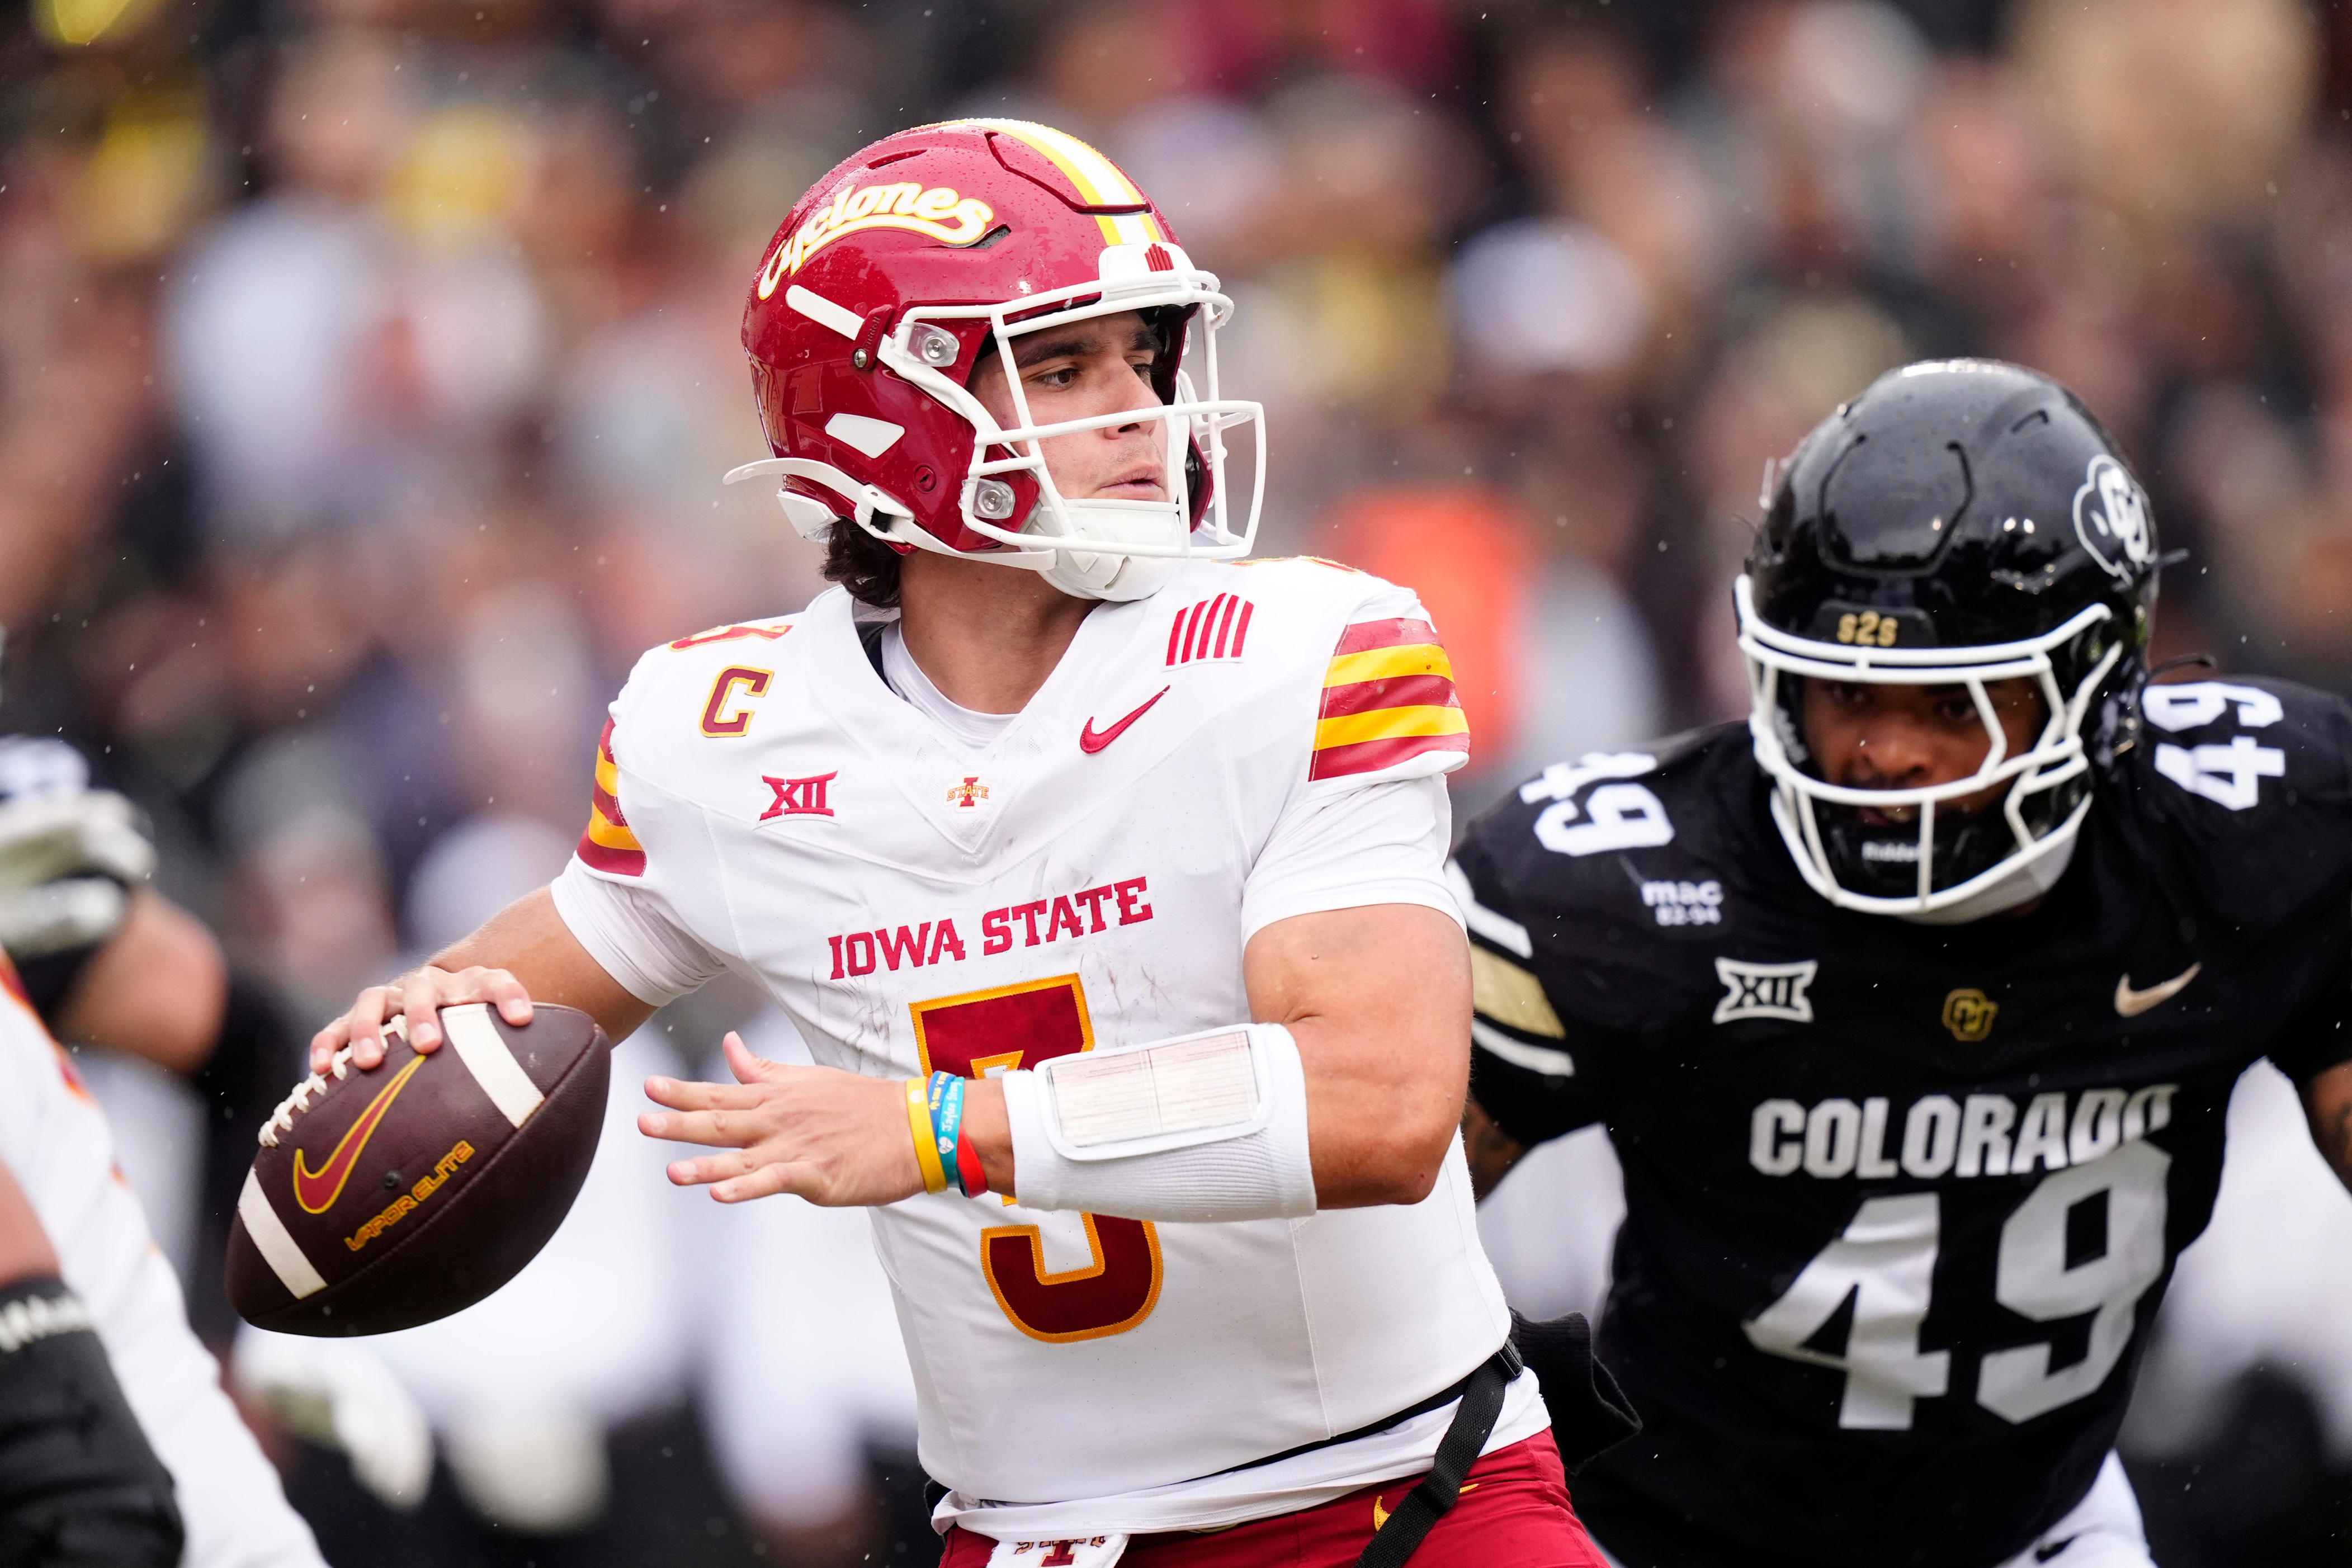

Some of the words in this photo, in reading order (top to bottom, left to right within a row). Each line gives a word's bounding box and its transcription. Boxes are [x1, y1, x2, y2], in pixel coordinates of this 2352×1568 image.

[758, 182, 993, 300] Cyclones
[699, 664, 774, 738] C
[2142, 681, 2285, 811] 49
[759, 770, 839, 821] XII
[946, 785, 990, 801] STATE
[828, 918, 966, 981] IOWA
[982, 876, 1153, 956] STATE
[1641, 880, 1724, 907] mac
[1713, 957, 1817, 1025] XII
[344, 1194, 419, 1251] VAPOR
[411, 1139, 475, 1202] ELITE
[1741, 1139, 2173, 1431] 49
